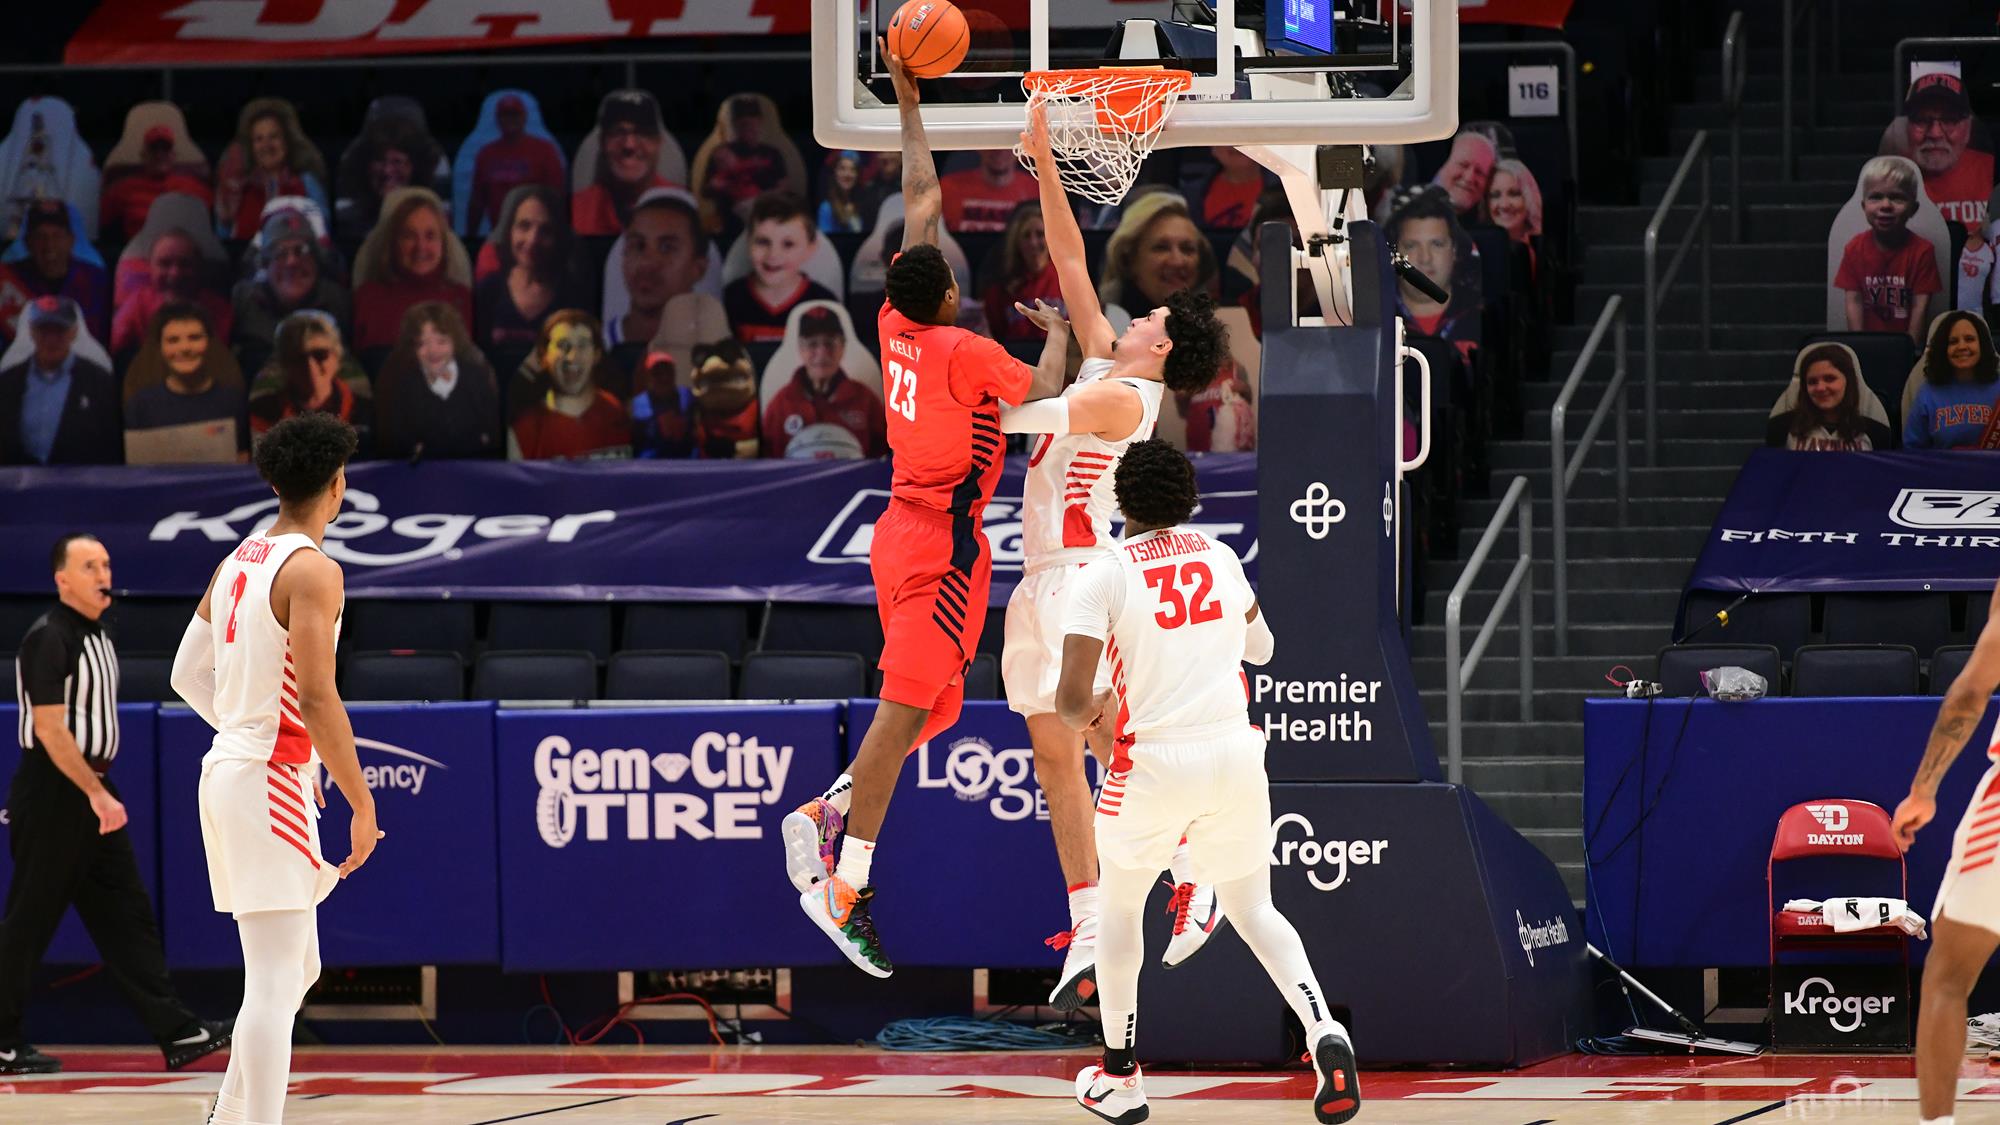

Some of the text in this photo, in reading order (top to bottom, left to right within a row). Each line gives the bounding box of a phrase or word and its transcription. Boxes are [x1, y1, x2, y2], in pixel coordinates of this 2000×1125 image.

[1518, 82, 1549, 99] 116
[889, 337, 922, 363] KELLY
[888, 360, 918, 422] 23
[148, 488, 617, 567] Koger
[1720, 528, 1859, 545] FIFTH
[1123, 532, 1211, 563] TSHIMANGA
[225, 571, 248, 643] 2
[1142, 561, 1223, 630] 32
[1254, 672, 1382, 704] Premier
[1264, 710, 1372, 742] Health
[324, 764, 427, 795] ency
[534, 731, 795, 805] Gem City
[572, 792, 764, 841] TIRE
[1807, 834, 1864, 846] DAYTON
[1526, 920, 1552, 949] Premier
[1797, 915, 1823, 926] DAYT
[1784, 976, 1896, 1033] Kroger
